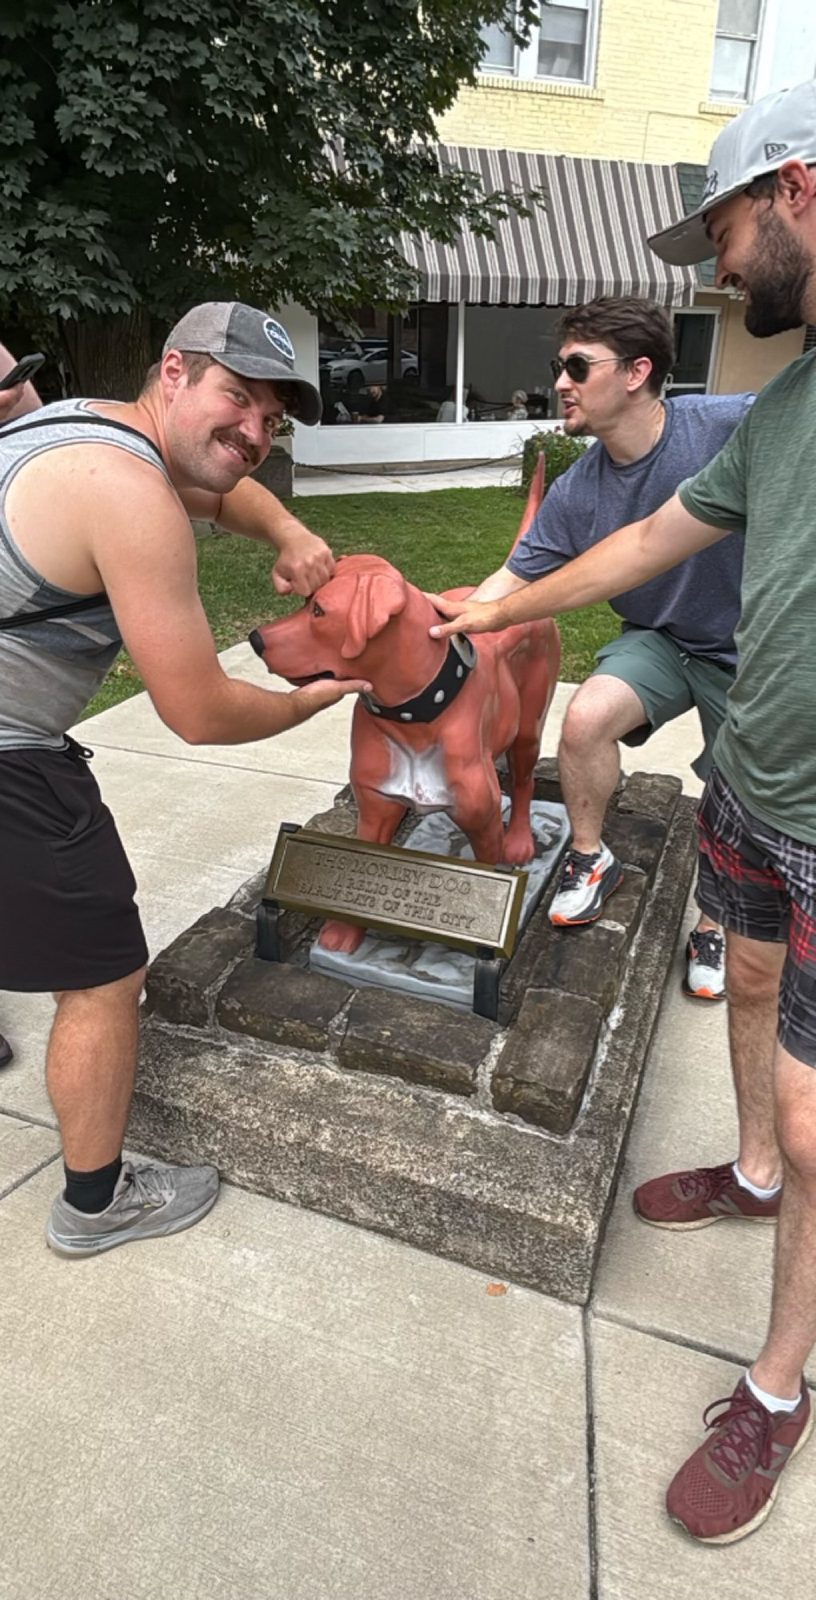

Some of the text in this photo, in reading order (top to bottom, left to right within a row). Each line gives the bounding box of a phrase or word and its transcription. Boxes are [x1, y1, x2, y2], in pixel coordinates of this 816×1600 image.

[346, 877, 388, 896] RELIC
[391, 887, 411, 901] OF
[413, 890, 442, 908] THE
[351, 857, 427, 886] MORLEY
[428, 872, 471, 896] DOG
[343, 890, 376, 908] DAYS
[382, 899, 401, 914] OF
[403, 902, 434, 921] THIS
[440, 911, 476, 929] CITY
